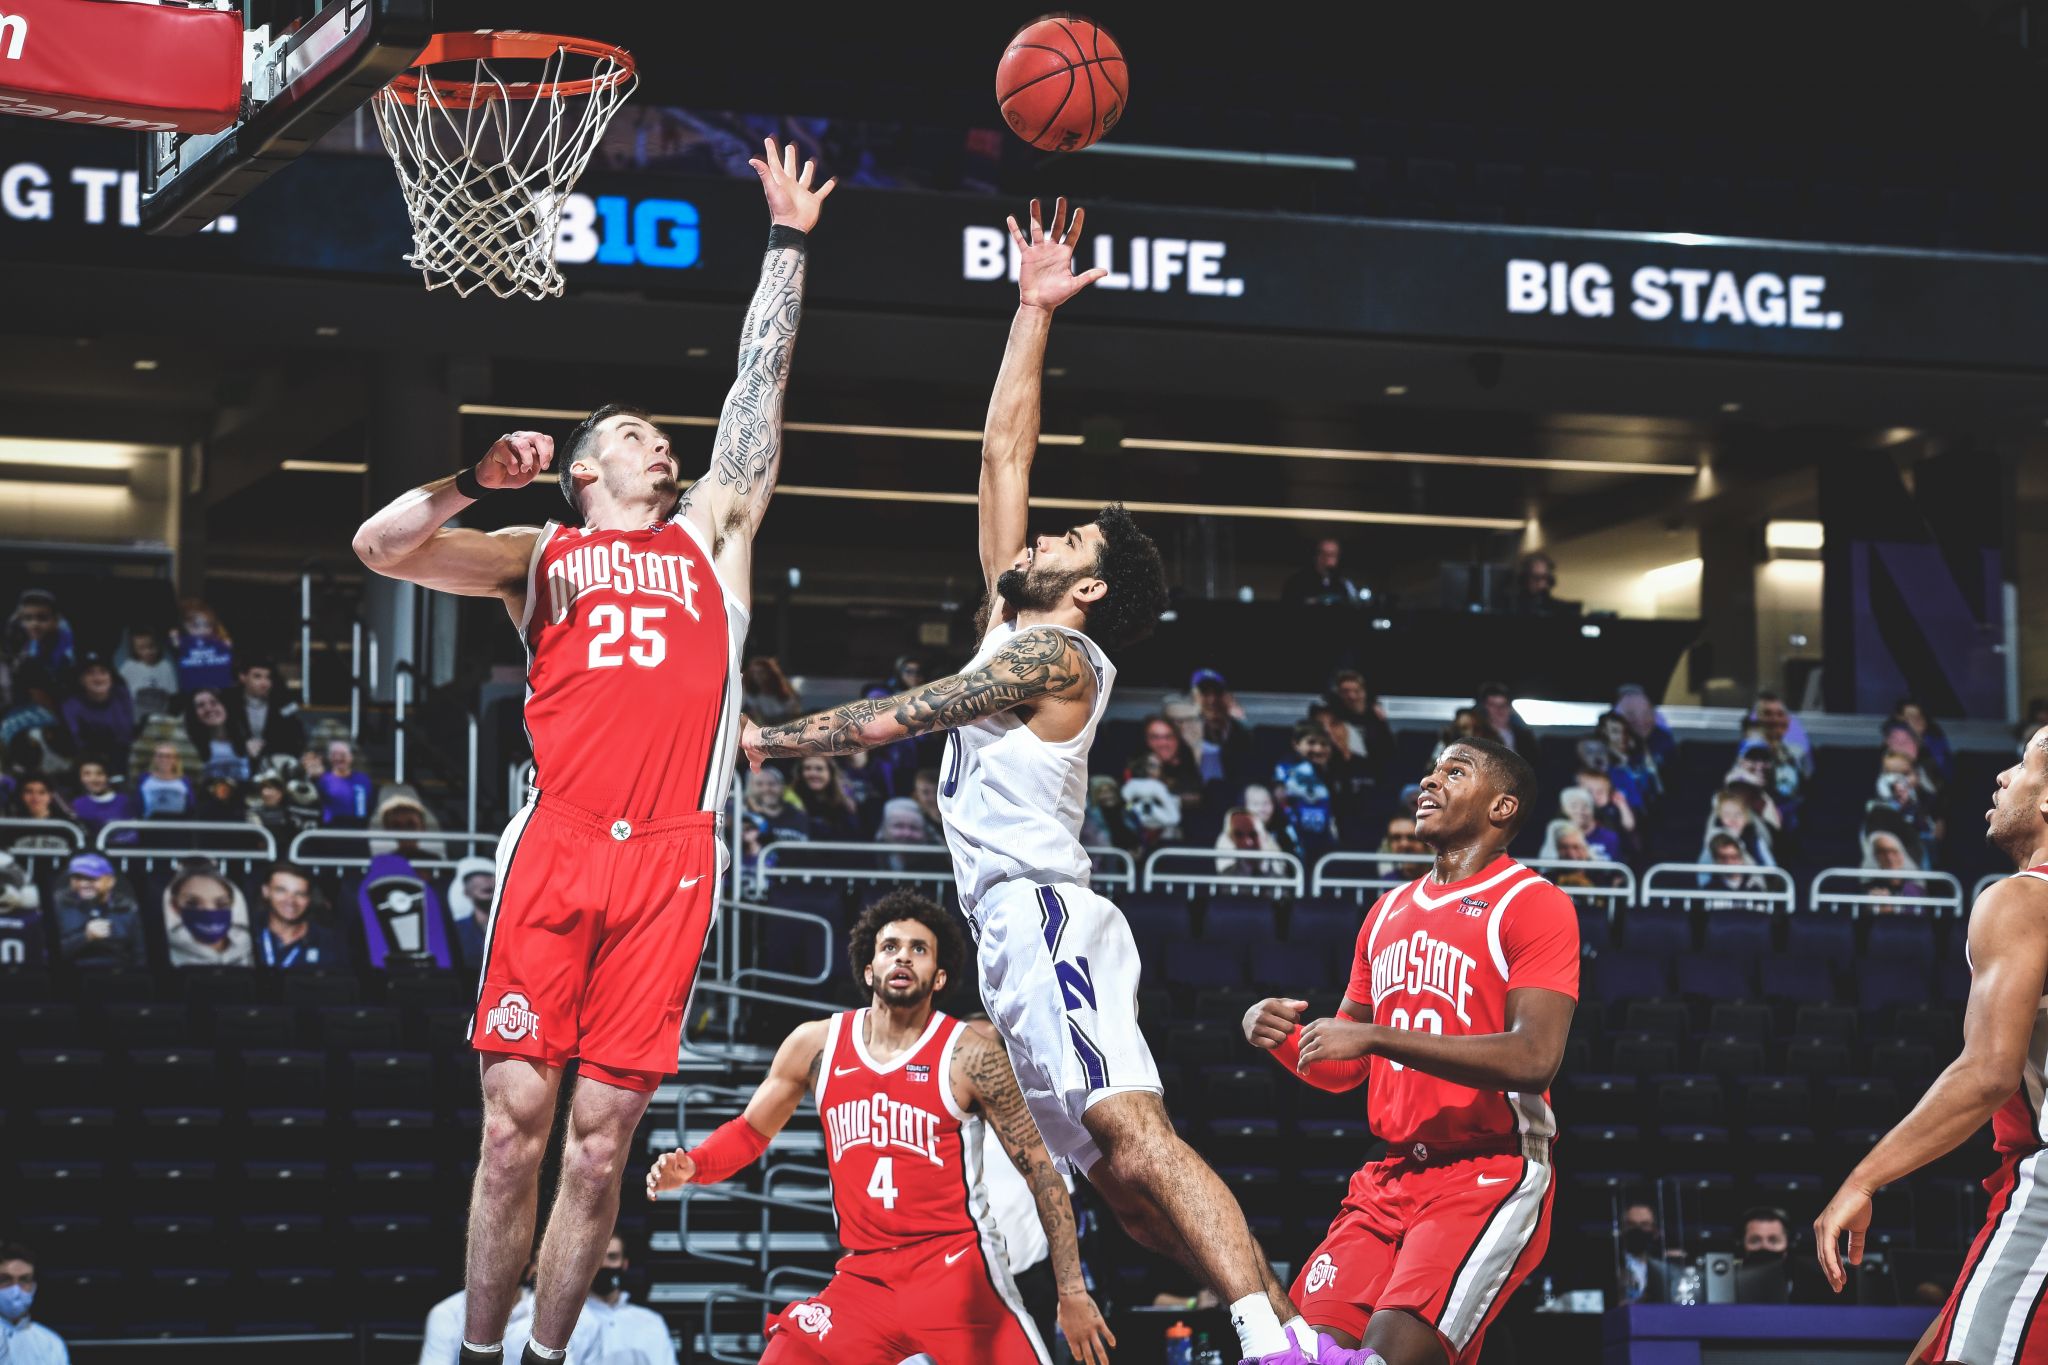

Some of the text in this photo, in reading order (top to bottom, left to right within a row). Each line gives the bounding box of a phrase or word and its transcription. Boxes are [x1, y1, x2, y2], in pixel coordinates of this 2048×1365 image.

[1094, 234, 1245, 297] LIFE.
[1507, 259, 1844, 330] BIG STAGE.
[587, 604, 667, 669] 25
[1054, 955, 1097, 1013] N
[866, 1156, 899, 1210] 4
